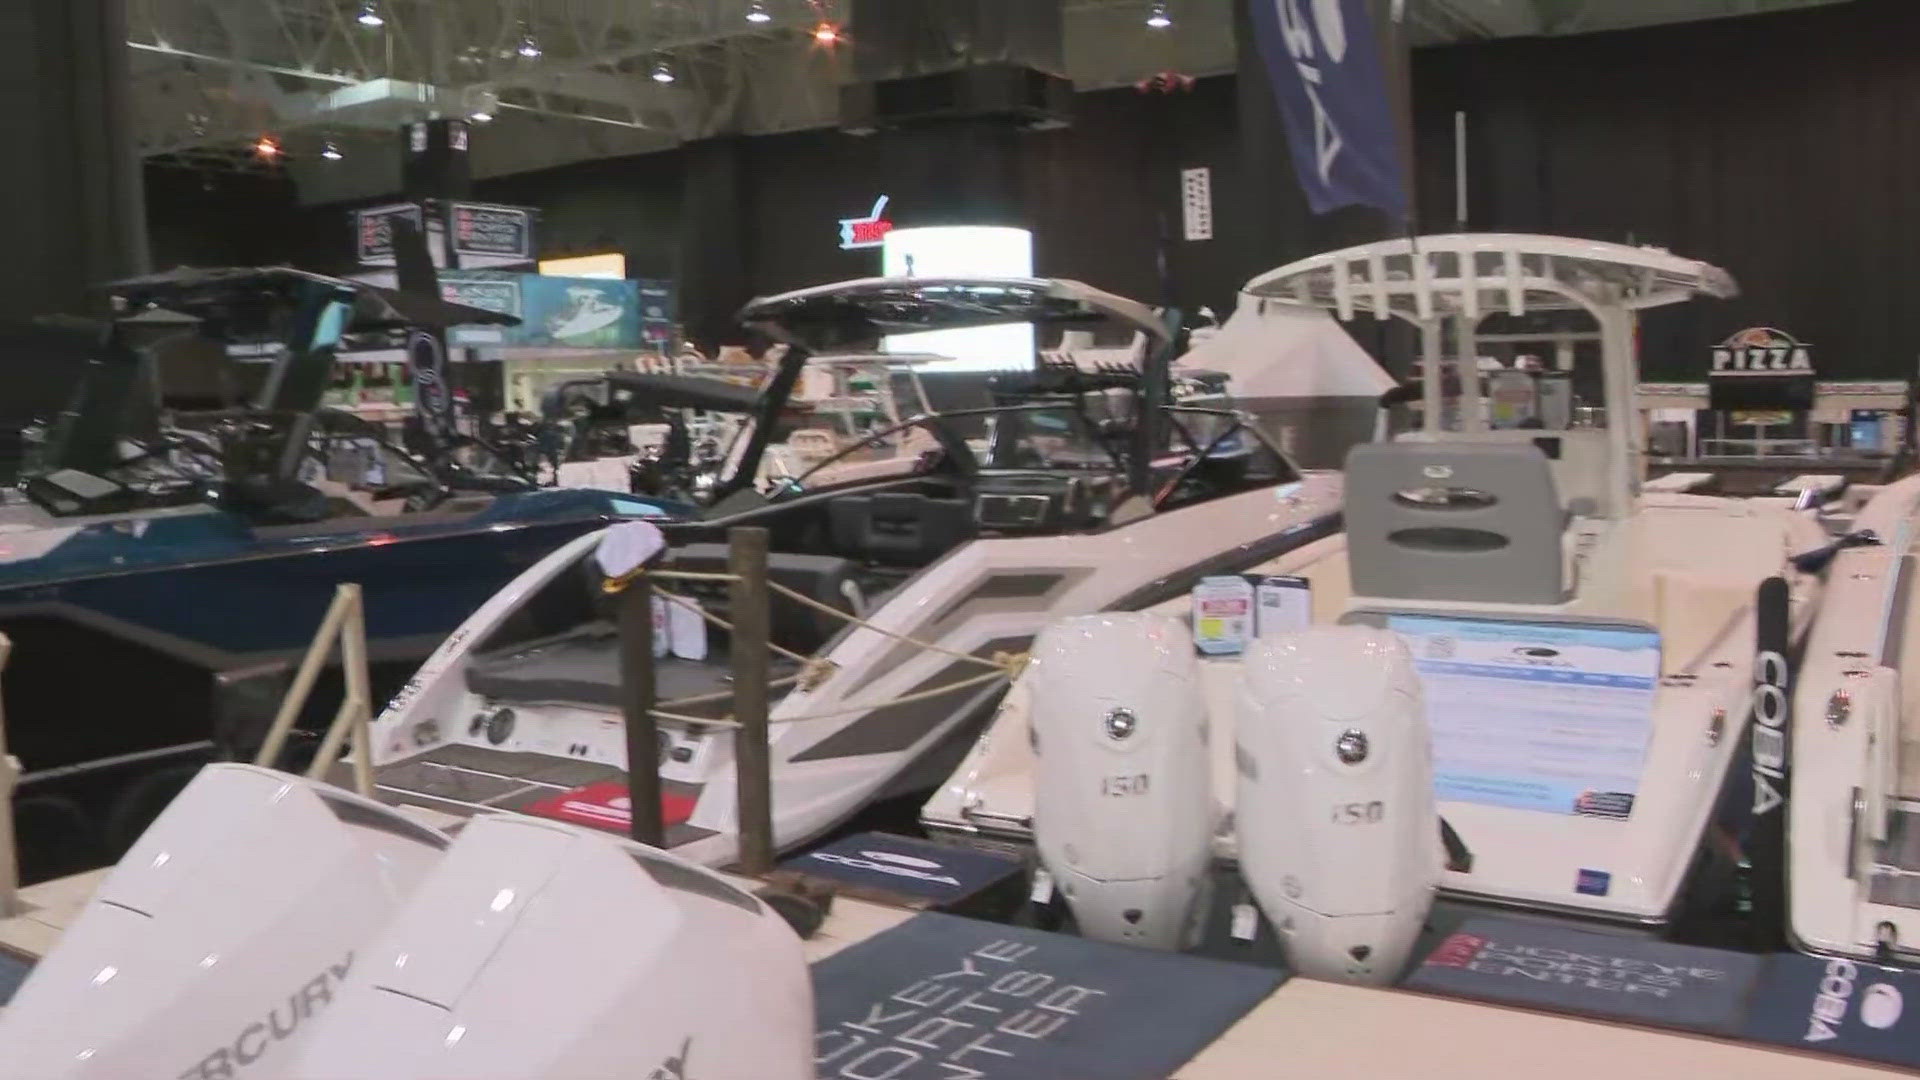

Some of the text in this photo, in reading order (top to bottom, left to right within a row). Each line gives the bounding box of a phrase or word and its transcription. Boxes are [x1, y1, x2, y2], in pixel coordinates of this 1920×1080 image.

[1712, 349, 1811, 371] PIZZA
[1752, 650, 1788, 816] COBIA
[1803, 960, 1858, 1042] COBIA
